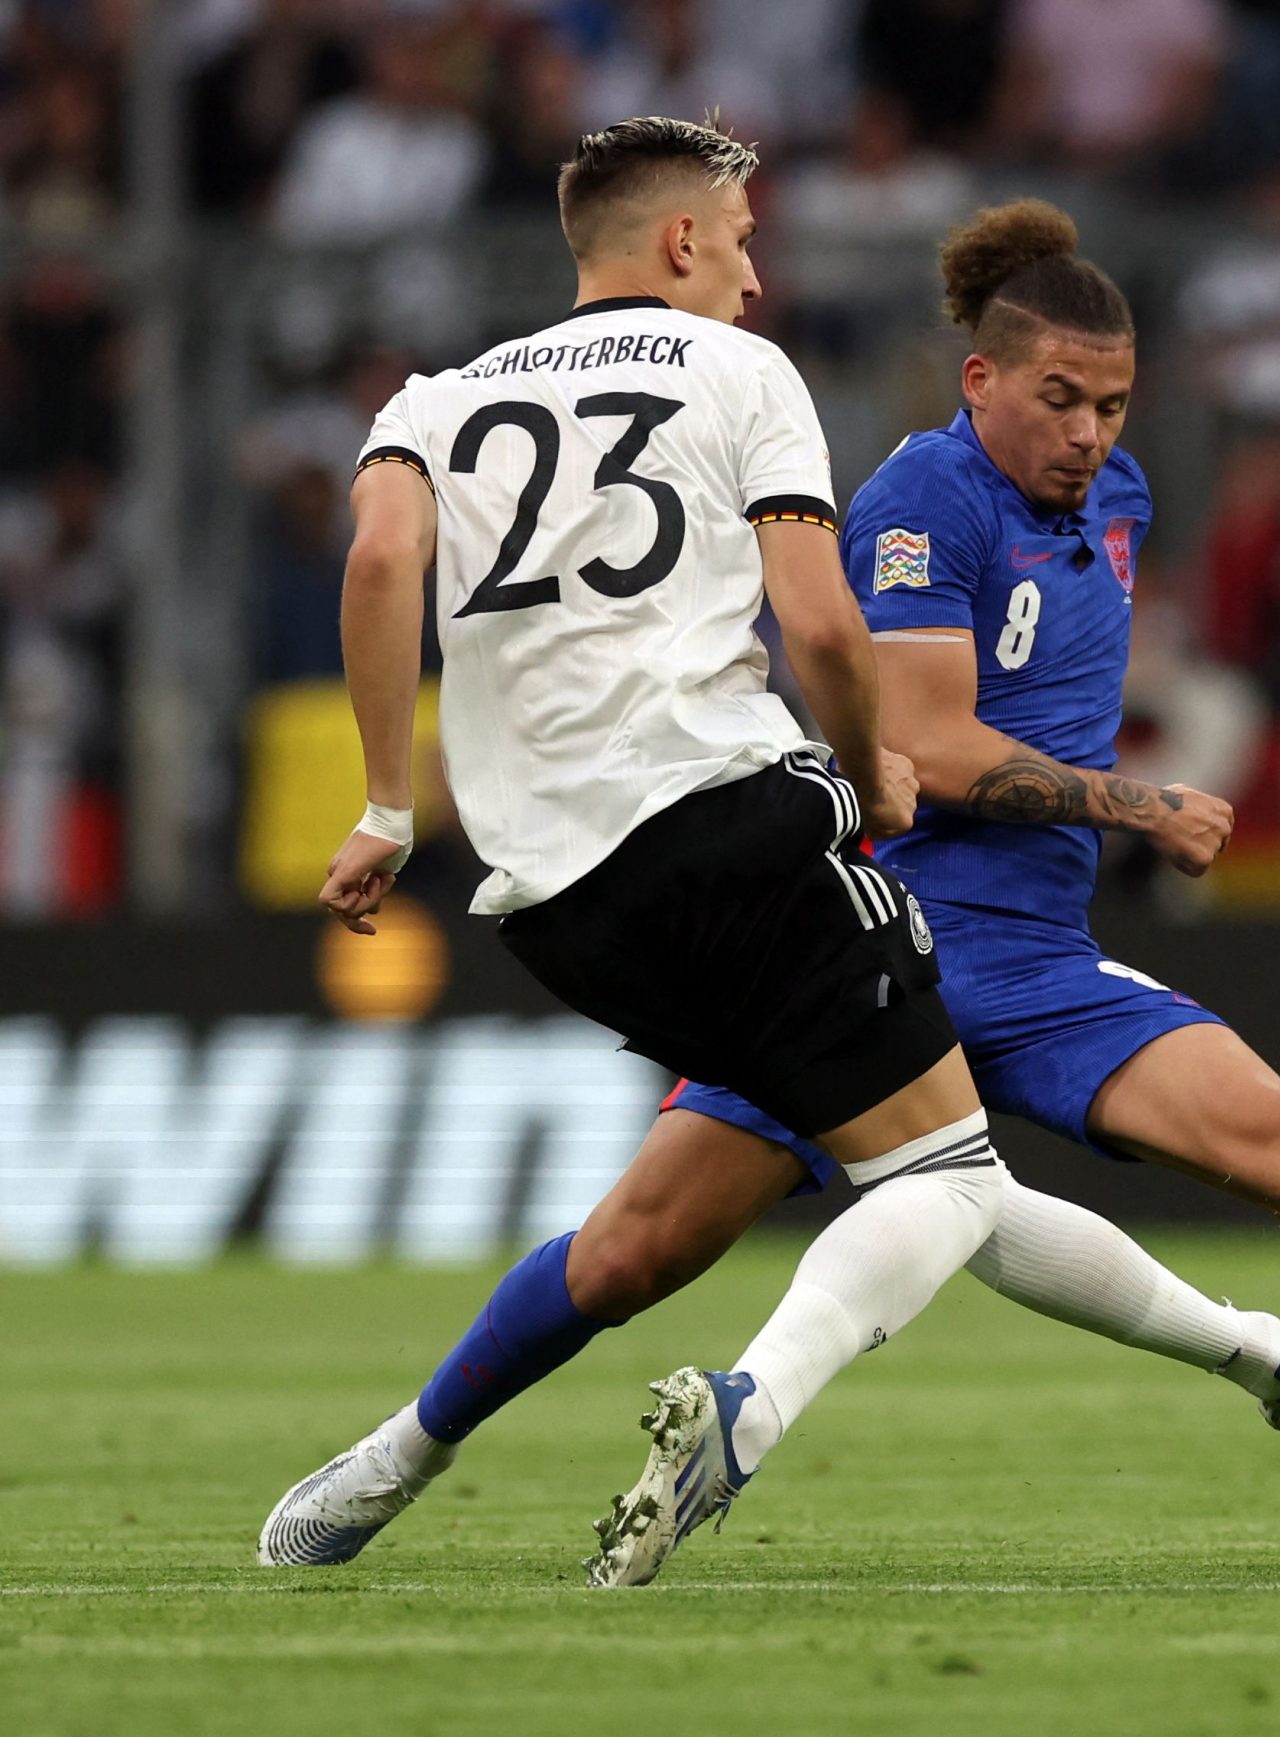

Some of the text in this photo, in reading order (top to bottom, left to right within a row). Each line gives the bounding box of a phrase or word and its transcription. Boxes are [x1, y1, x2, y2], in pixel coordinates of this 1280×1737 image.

[461, 334, 694, 380] SCHLOTTERBECK
[448, 391, 687, 619] 23
[995, 579, 1042, 672] 8
